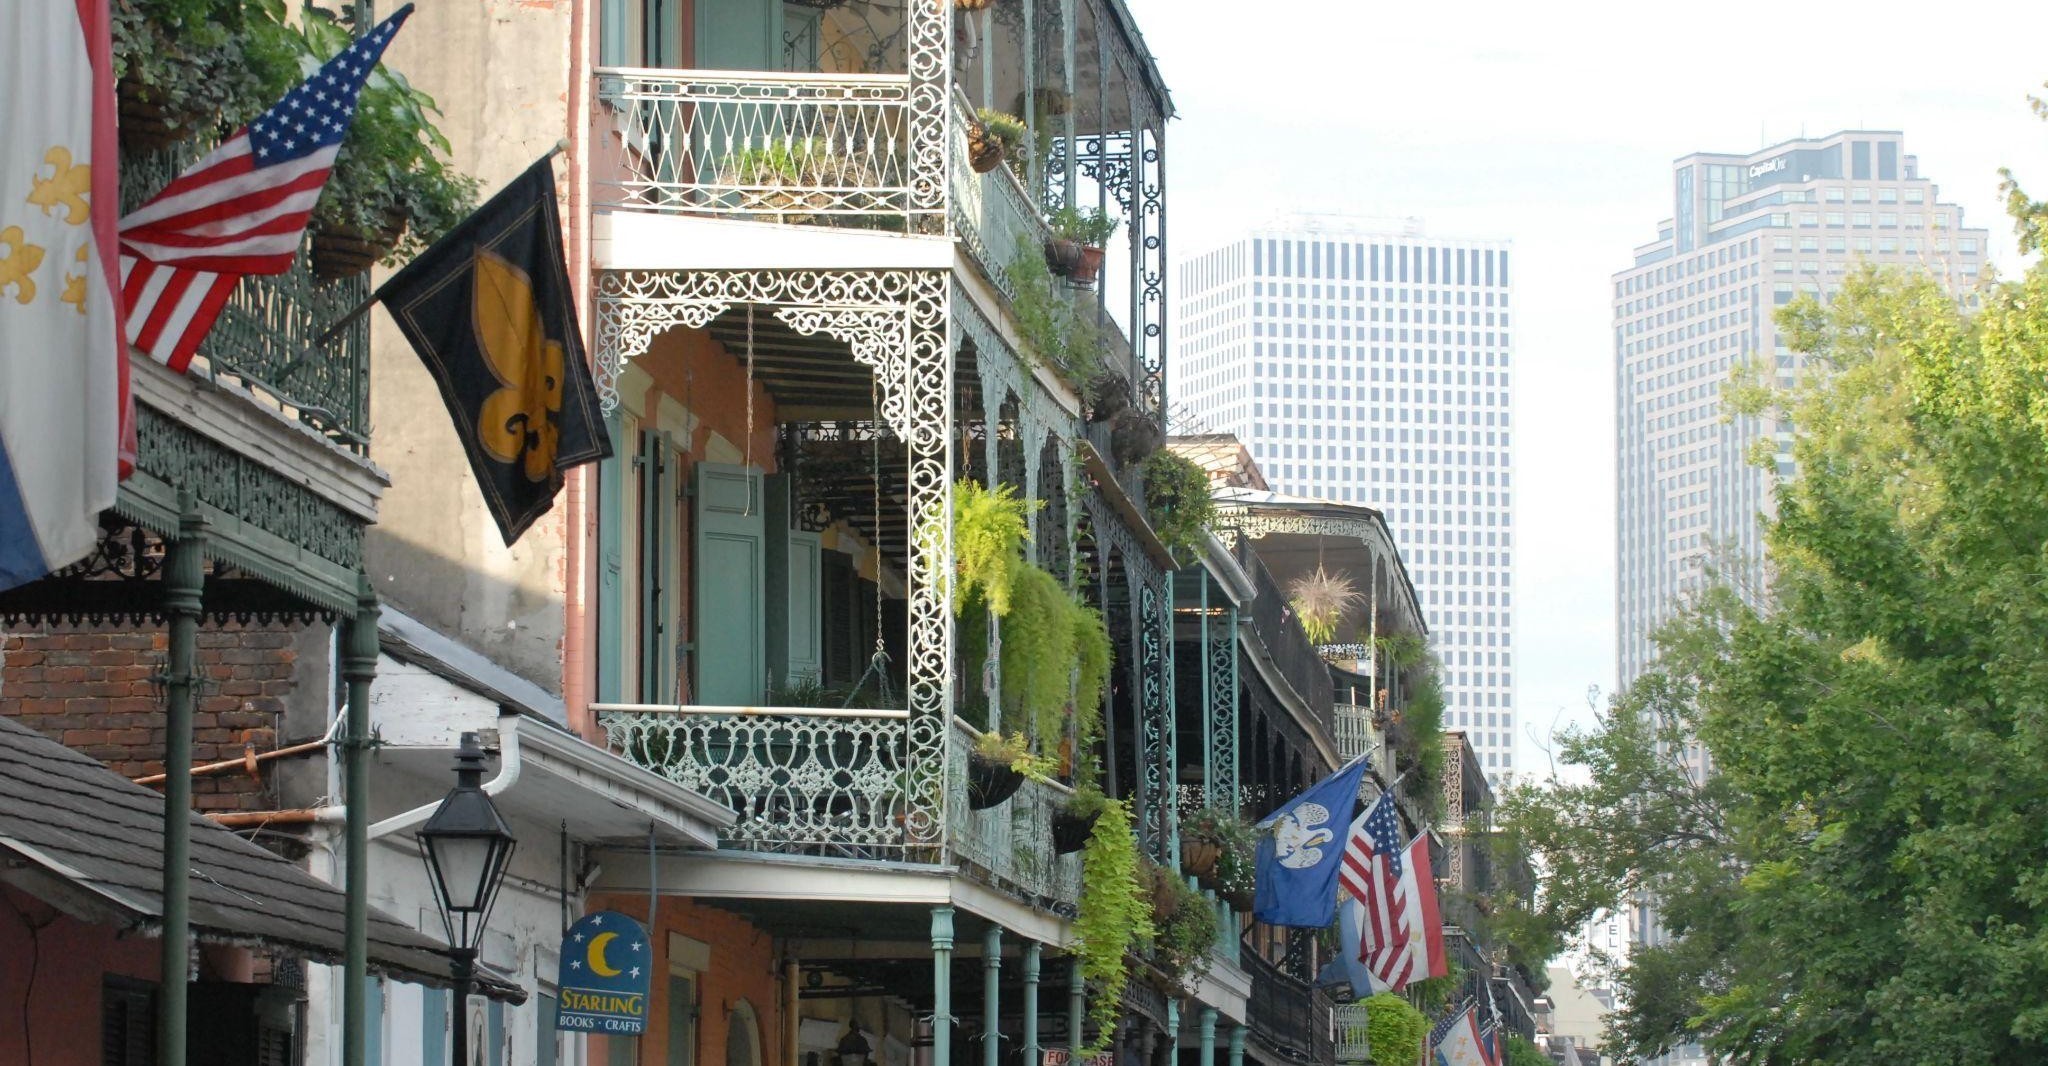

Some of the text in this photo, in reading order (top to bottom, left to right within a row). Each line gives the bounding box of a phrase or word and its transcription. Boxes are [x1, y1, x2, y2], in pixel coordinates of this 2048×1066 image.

[561, 989, 643, 1016] STARLING
[560, 1015, 642, 1033] BOOKS CRAFTS
